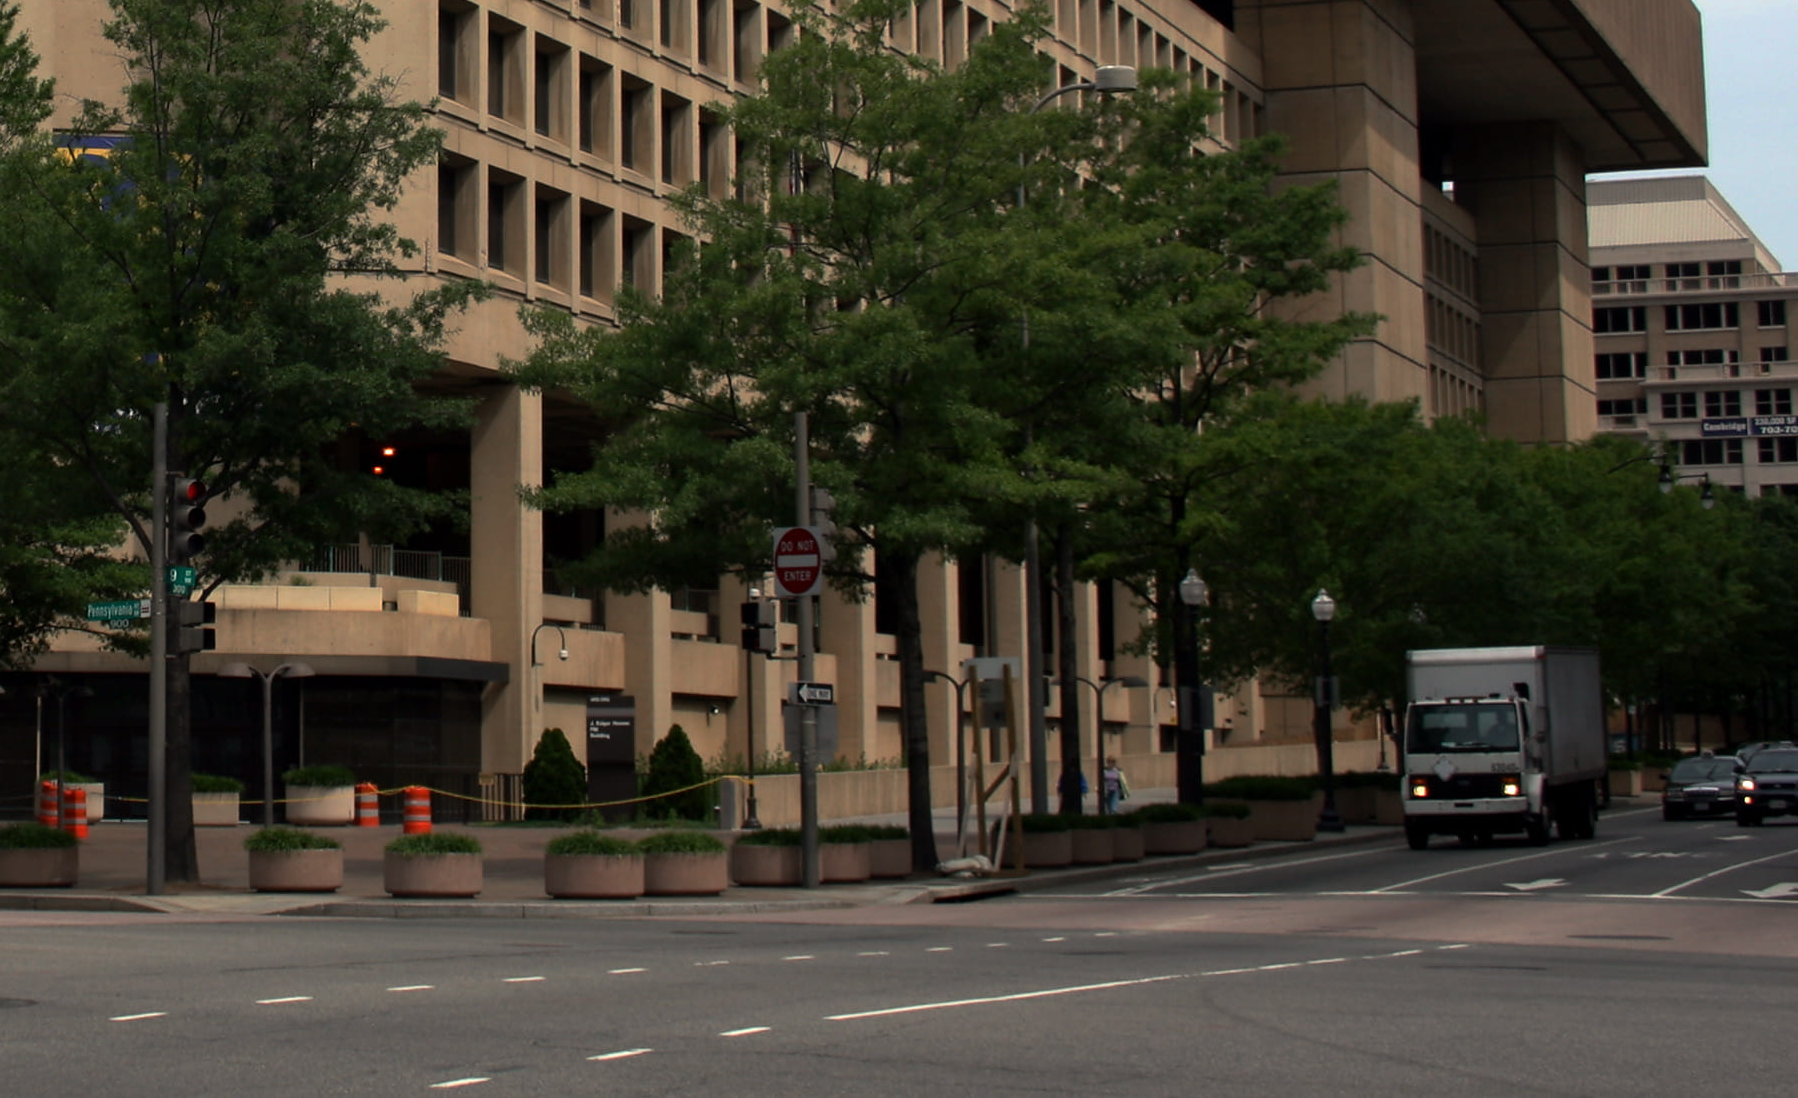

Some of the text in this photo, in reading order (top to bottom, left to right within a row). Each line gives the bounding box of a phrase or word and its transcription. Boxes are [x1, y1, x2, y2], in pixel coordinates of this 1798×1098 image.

[1703, 422, 1746, 432] Cambridge
[781, 540, 814, 553] DO NOT
[169, 568, 177, 582] 9
[784, 570, 812, 582] ENTER
[87, 603, 132, 619] Pennsylvania
[110, 619, 129, 628] 900
